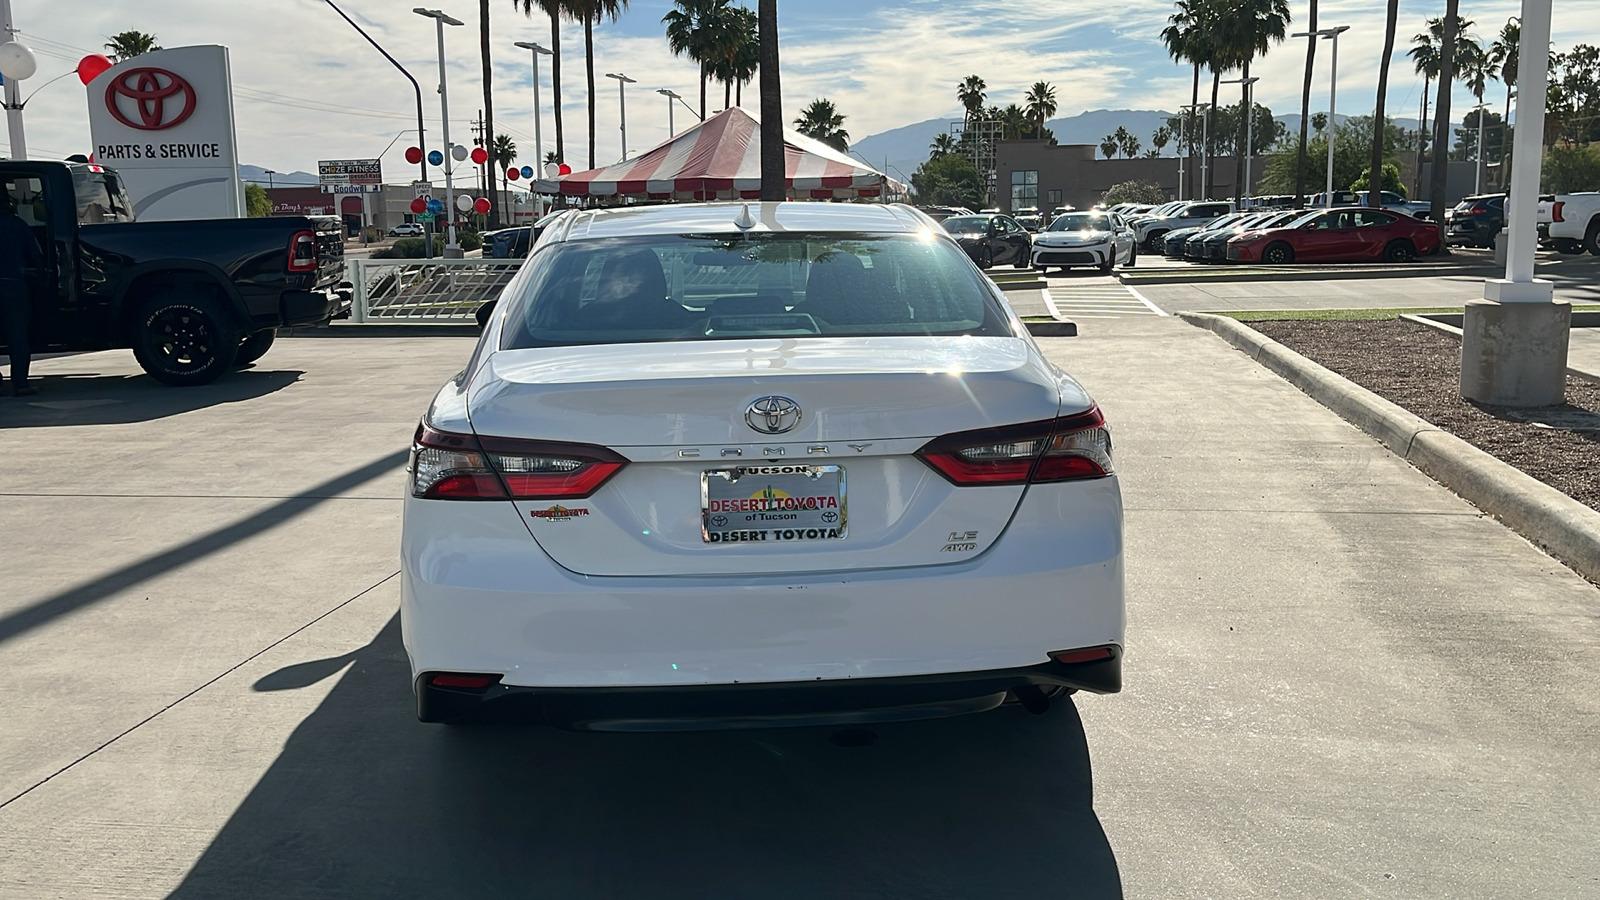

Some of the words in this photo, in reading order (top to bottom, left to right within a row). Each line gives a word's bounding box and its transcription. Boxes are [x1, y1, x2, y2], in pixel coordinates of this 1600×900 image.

[98, 144, 141, 159] PARTS
[145, 143, 156, 159] &
[160, 143, 220, 158] SERVICE
[347, 164, 379, 173] FITNESS
[333, 184, 367, 194] Goodwill
[280, 203, 301, 213] Boys
[678, 443, 873, 458] CAMRY
[738, 466, 808, 475] TUCSON
[710, 498, 769, 512] DESERT
[774, 496, 838, 511] TOYOTA
[745, 513, 757, 521] of
[758, 513, 797, 521] Tucson
[710, 530, 768, 543] DESERT
[774, 528, 838, 541] TOYOTA
[948, 531, 979, 542] LE
[940, 542, 978, 552] AWD
